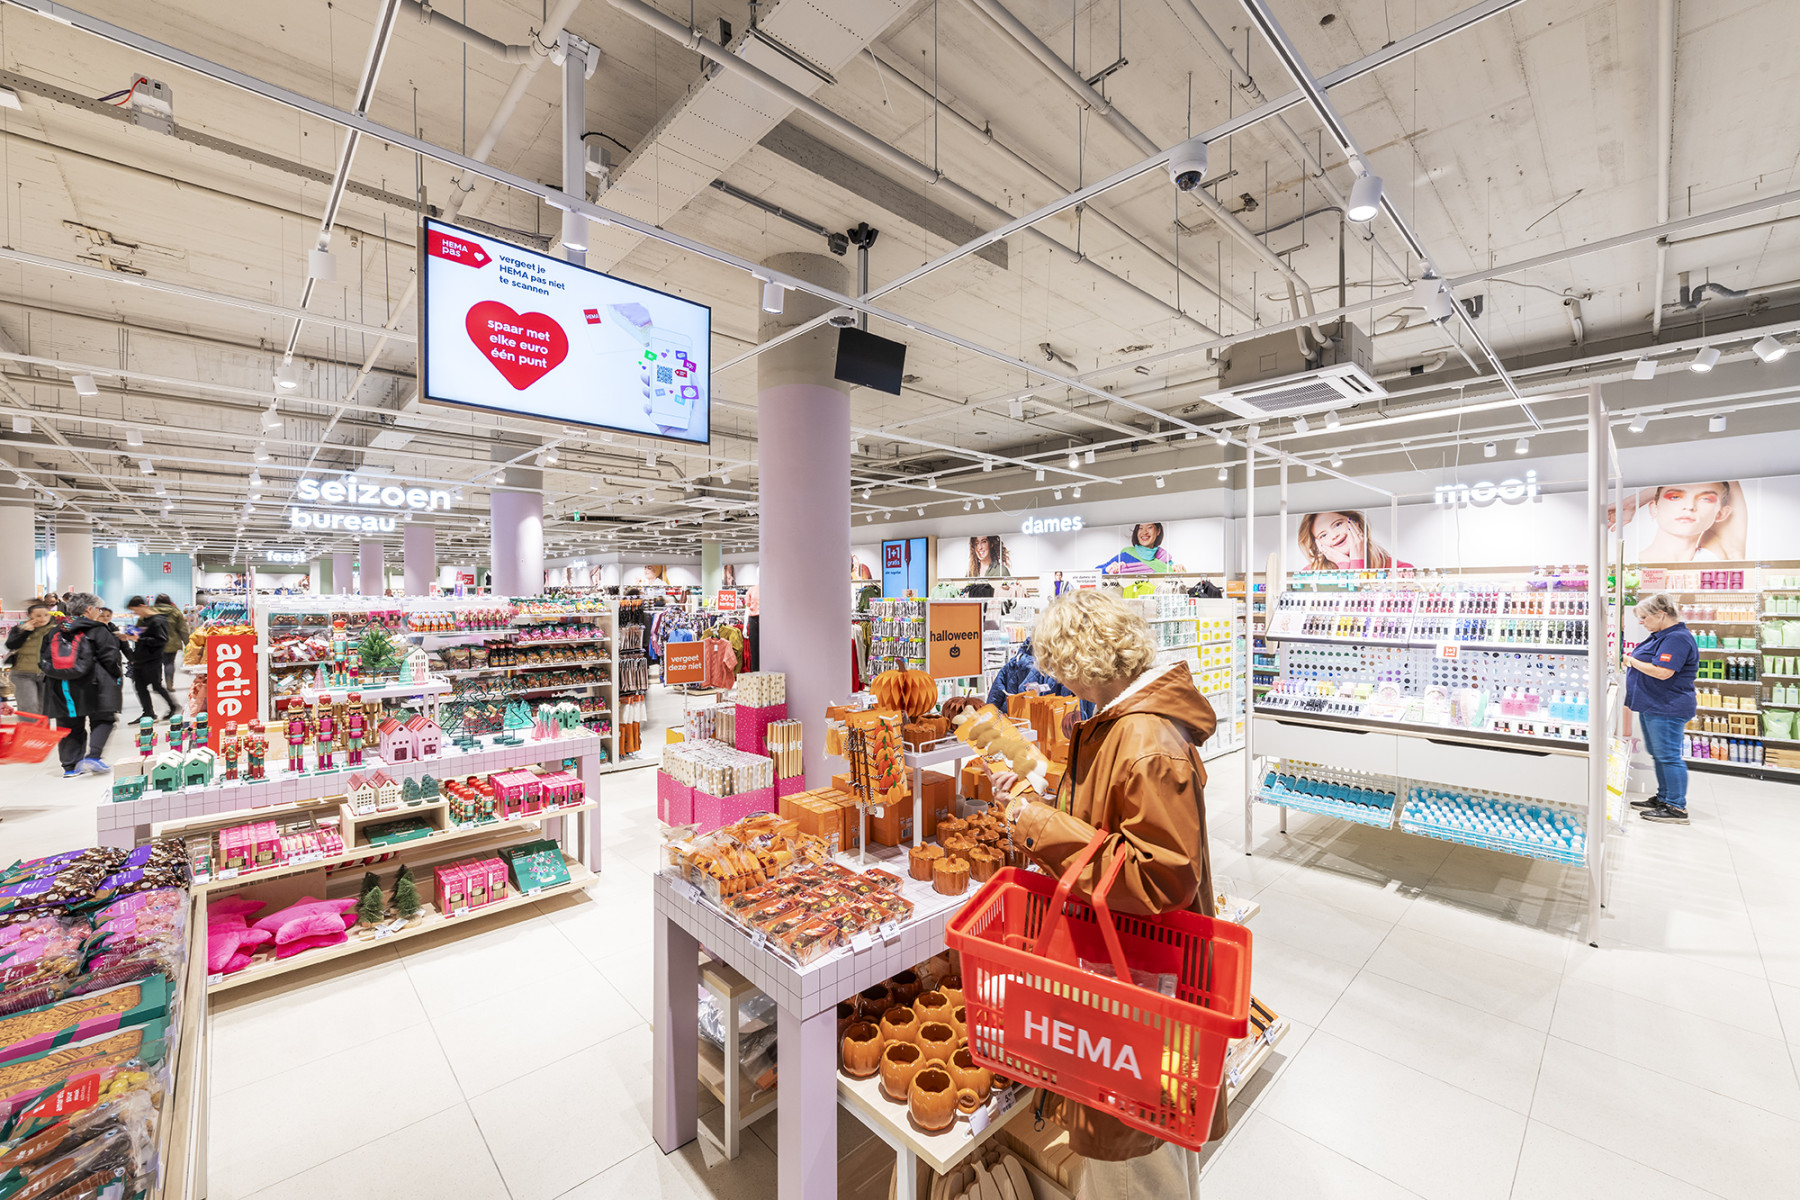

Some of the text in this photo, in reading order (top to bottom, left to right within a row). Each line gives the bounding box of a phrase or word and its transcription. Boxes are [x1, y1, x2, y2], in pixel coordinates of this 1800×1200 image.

[442, 239, 468, 252] HEMA
[442, 247, 461, 257] pas
[499, 255, 546, 273] vergeet je
[499, 265, 565, 290] HEMA pas niet
[499, 275, 549, 296] te scannen
[487, 319, 550, 342] spaar met
[489, 334, 549, 355] elke euro
[490, 347, 547, 368] één punt
[298, 476, 451, 510] seizoen
[1435, 469, 1537, 505] mooi
[291, 507, 396, 532] bureau
[1022, 515, 1083, 535] dames
[267, 550, 306, 563] feest
[887, 546, 900, 559] 1+1
[720, 594, 735, 602] 30%
[930, 630, 979, 642] halloween
[668, 662, 702, 671] deze niet
[671, 654, 699, 664] vergeet
[216, 643, 251, 717] actie
[1024, 1010, 1142, 1080] HEMA
